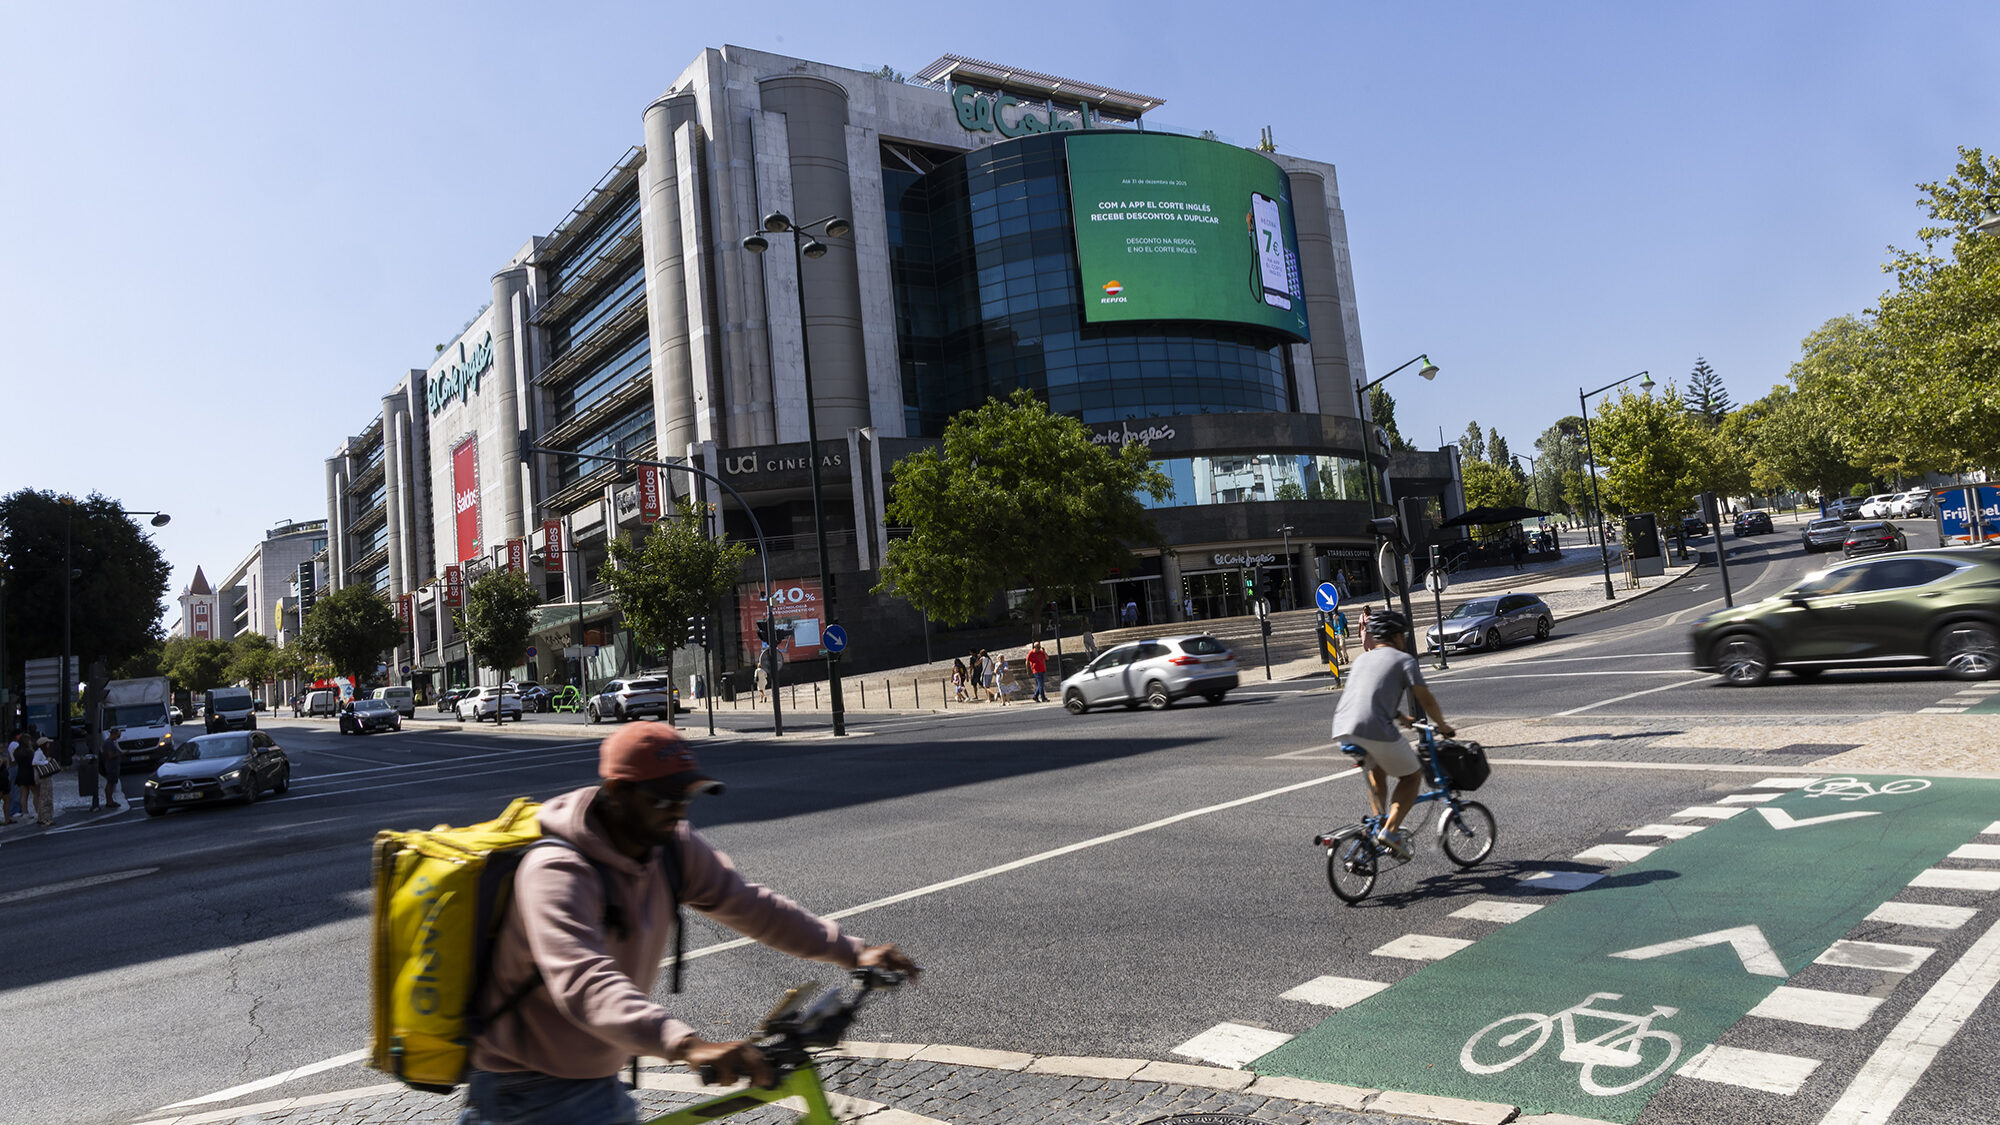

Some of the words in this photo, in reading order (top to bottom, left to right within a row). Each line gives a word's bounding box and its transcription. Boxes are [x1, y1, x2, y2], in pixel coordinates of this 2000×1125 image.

[953, 84, 994, 132] El
[1091, 213, 1124, 221] RECEBE
[1126, 212, 1175, 221] DESCONTOS
[1184, 214, 1219, 224] DUPLICAR
[1098, 201, 1118, 209] COM
[1120, 201, 1127, 209] A
[1128, 201, 1145, 209] APP
[1147, 201, 1157, 209] EL
[1158, 201, 1184, 210] CORTE
[1185, 202, 1211, 212] INGLÉS
[1126, 237, 1162, 245] DESCONTO
[1173, 238, 1196, 246] REPSOL
[1262, 229, 1272, 253] 7
[1101, 296, 1127, 304] REPSOL
[1092, 429, 1121, 444] orte
[1121, 421, 1176, 448] Inglés
[456, 488, 478, 514] Saldos
[645, 470, 657, 510] Saldos
[548, 527, 559, 559] sales
[1327, 549, 1353, 558] STARBUCKS
[1354, 550, 1370, 558] COFFEE
[1214, 553, 1224, 565] El
[1223, 552, 1245, 565] Corte
[1245, 550, 1276, 567] Inglés
[450, 570, 459, 597] sales
